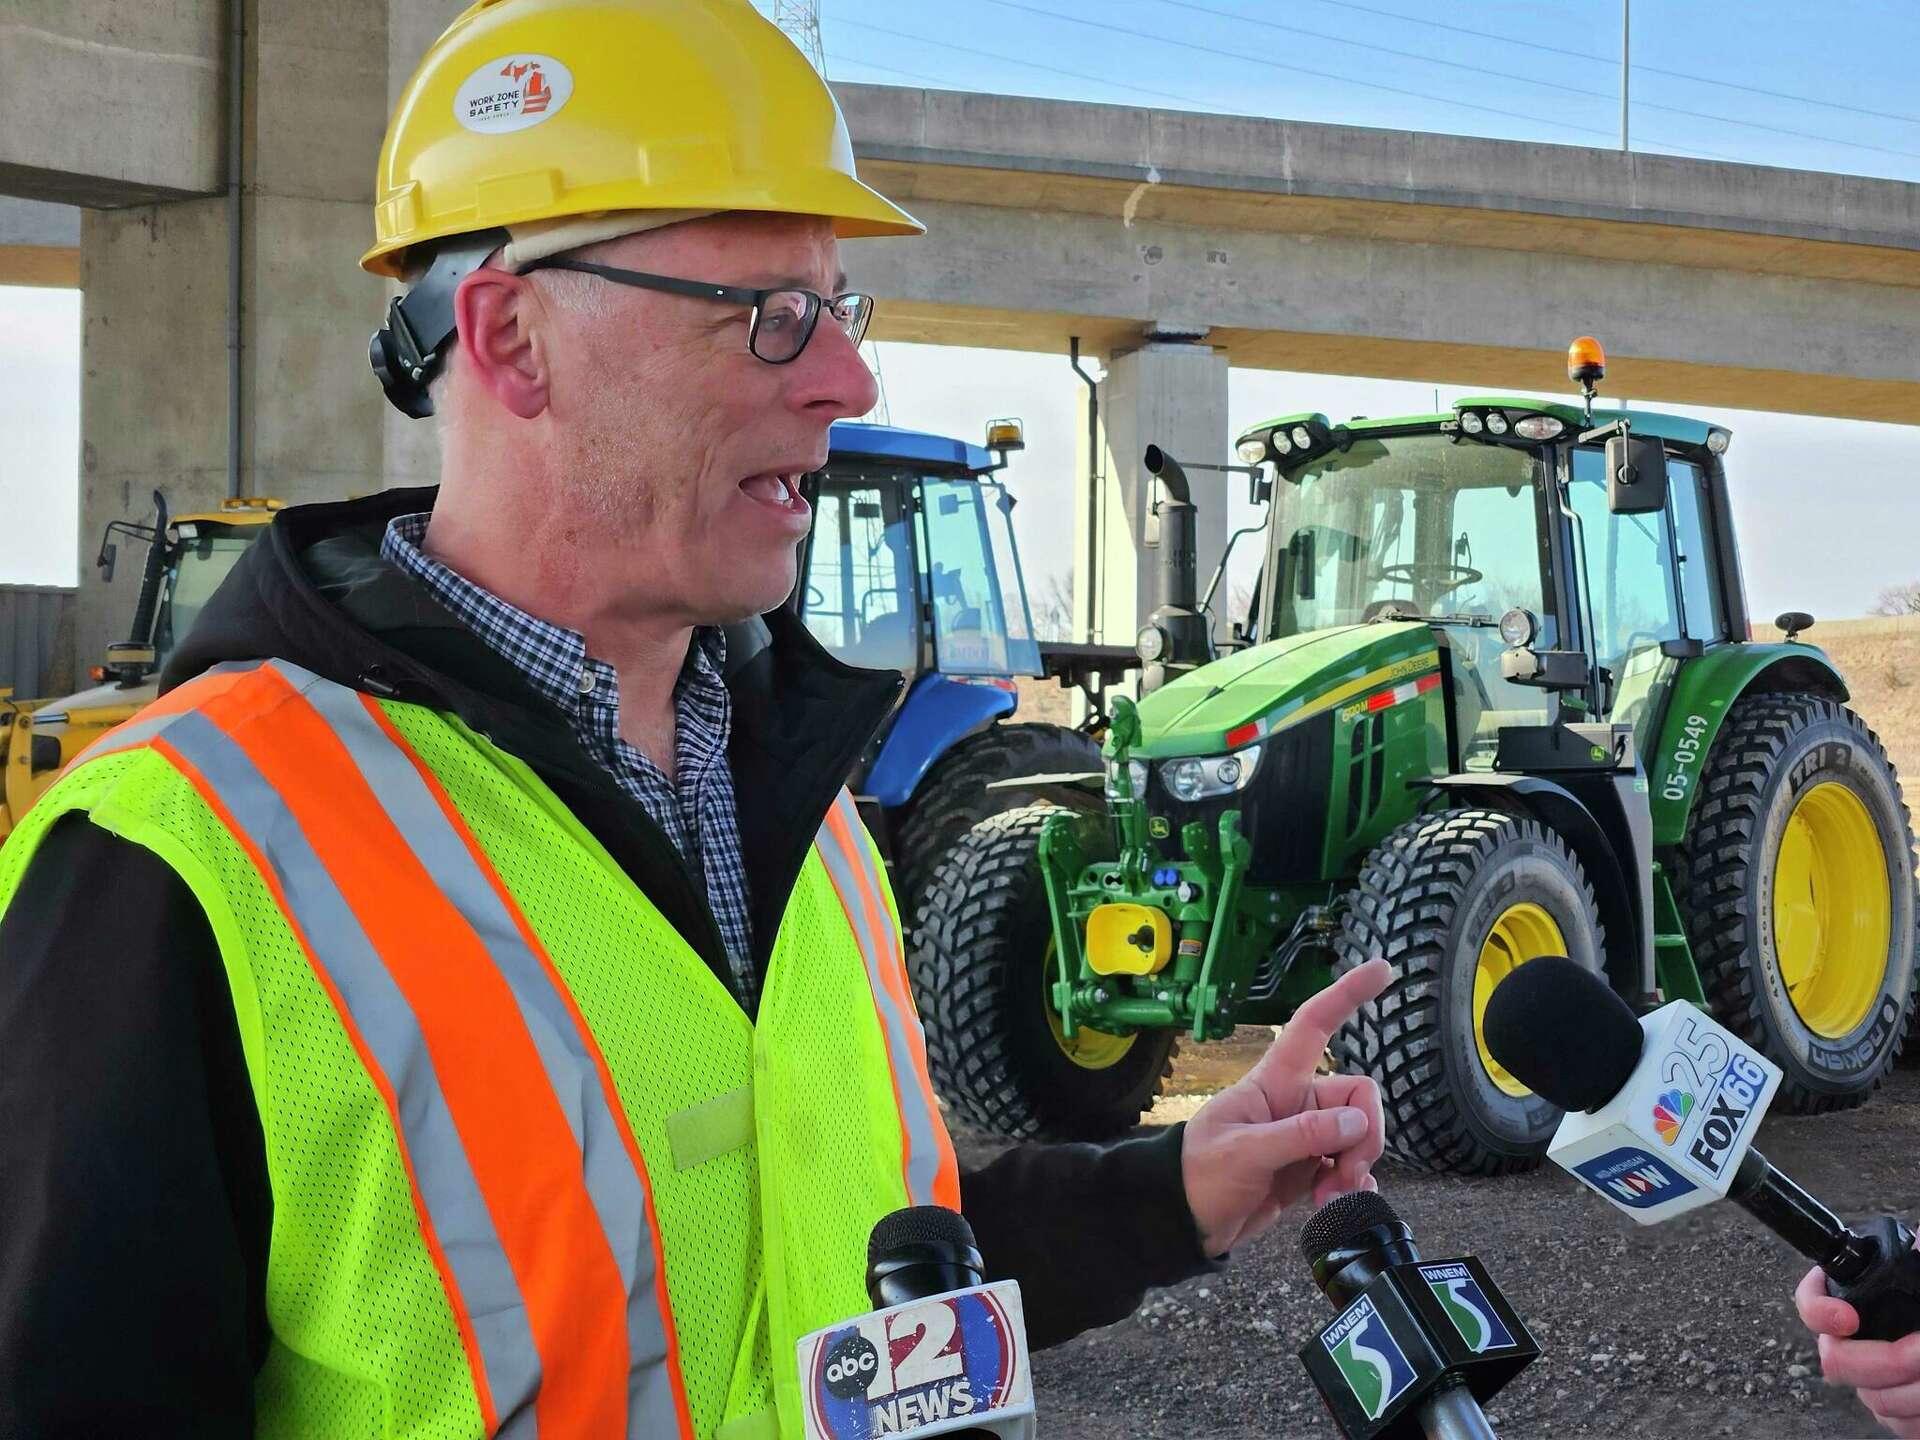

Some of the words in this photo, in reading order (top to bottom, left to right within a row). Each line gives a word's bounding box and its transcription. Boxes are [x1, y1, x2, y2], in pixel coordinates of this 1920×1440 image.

[469, 95, 495, 108] WORK
[497, 90, 520, 102] ZONE
[469, 100, 519, 117] SAFETY
[1407, 657, 1430, 674] DEERE
[1663, 714, 1708, 801] 05-0549
[1792, 747, 1826, 787] TRI
[1836, 748, 1847, 765] 2
[1661, 1017, 1730, 1111] 25
[1424, 1265, 1467, 1280] WNEM
[1325, 1300, 1371, 1346] WNEM
[1447, 1278, 1492, 1354] 5
[826, 1352, 876, 1383] abc
[858, 1302, 963, 1400] 12
[1349, 1315, 1393, 1419] 5
[874, 1381, 975, 1434] NEWS
